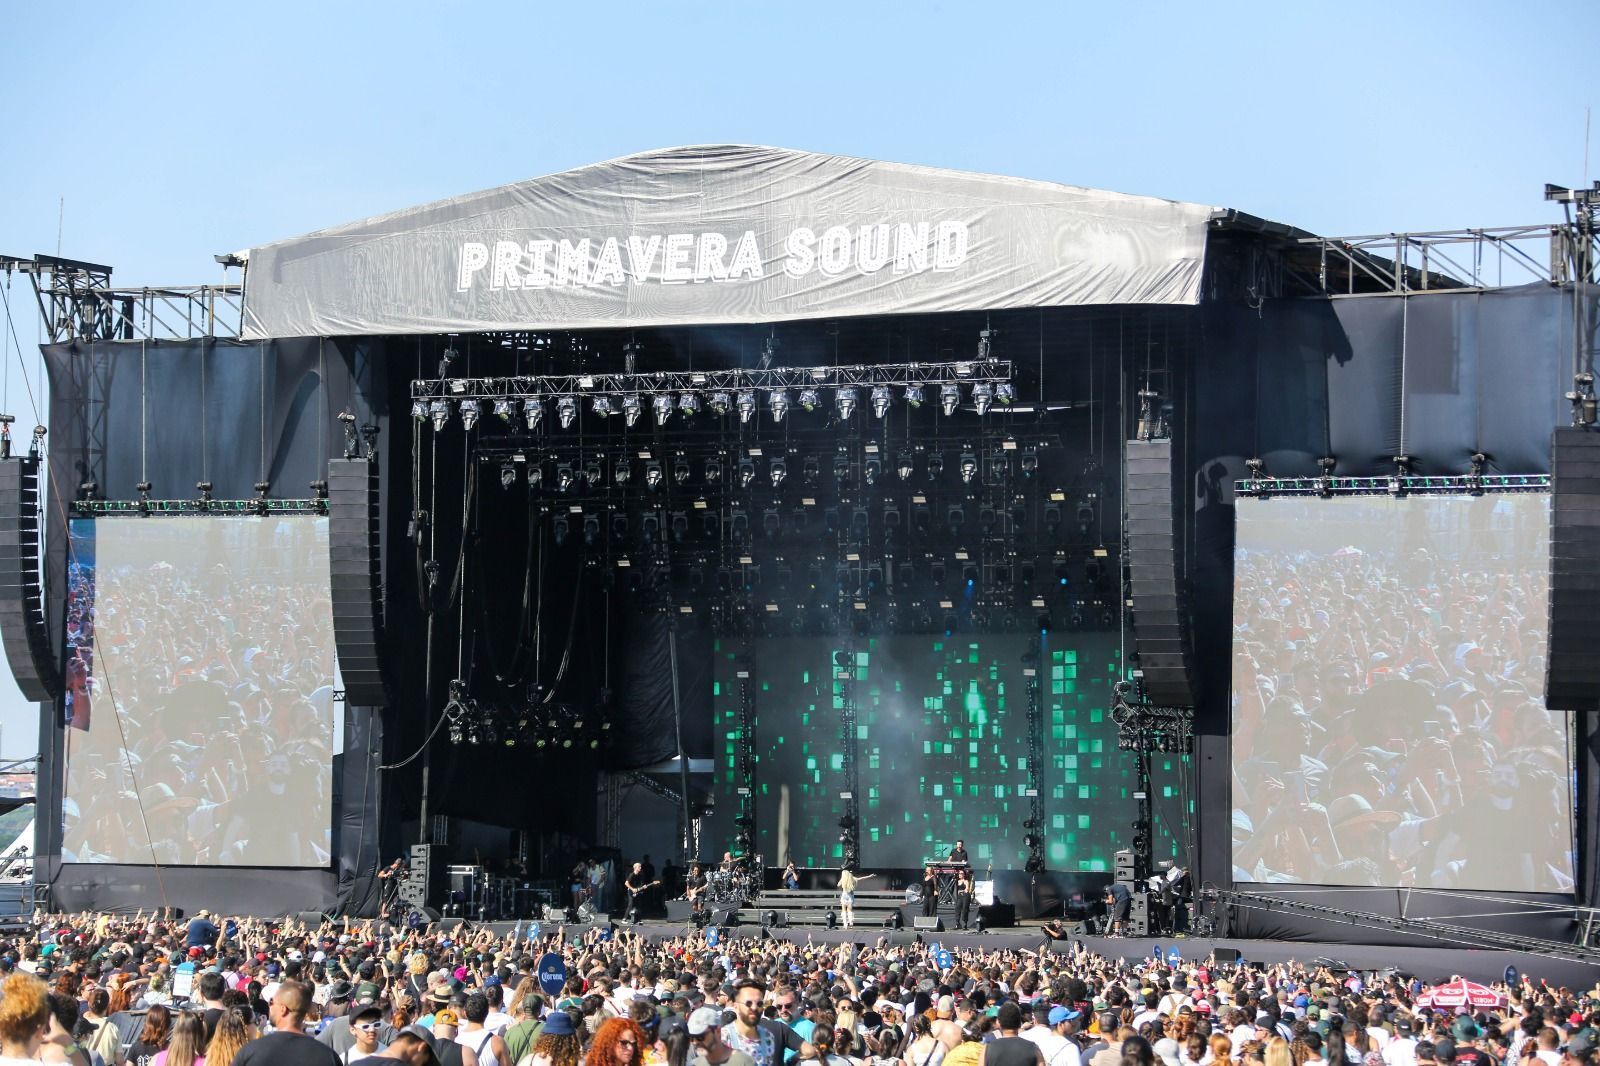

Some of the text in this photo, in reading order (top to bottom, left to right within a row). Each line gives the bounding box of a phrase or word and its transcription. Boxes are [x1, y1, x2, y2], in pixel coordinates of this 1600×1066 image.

[457, 220, 968, 292] PRIMAVERA SOUND
[541, 971, 563, 983] Corona
